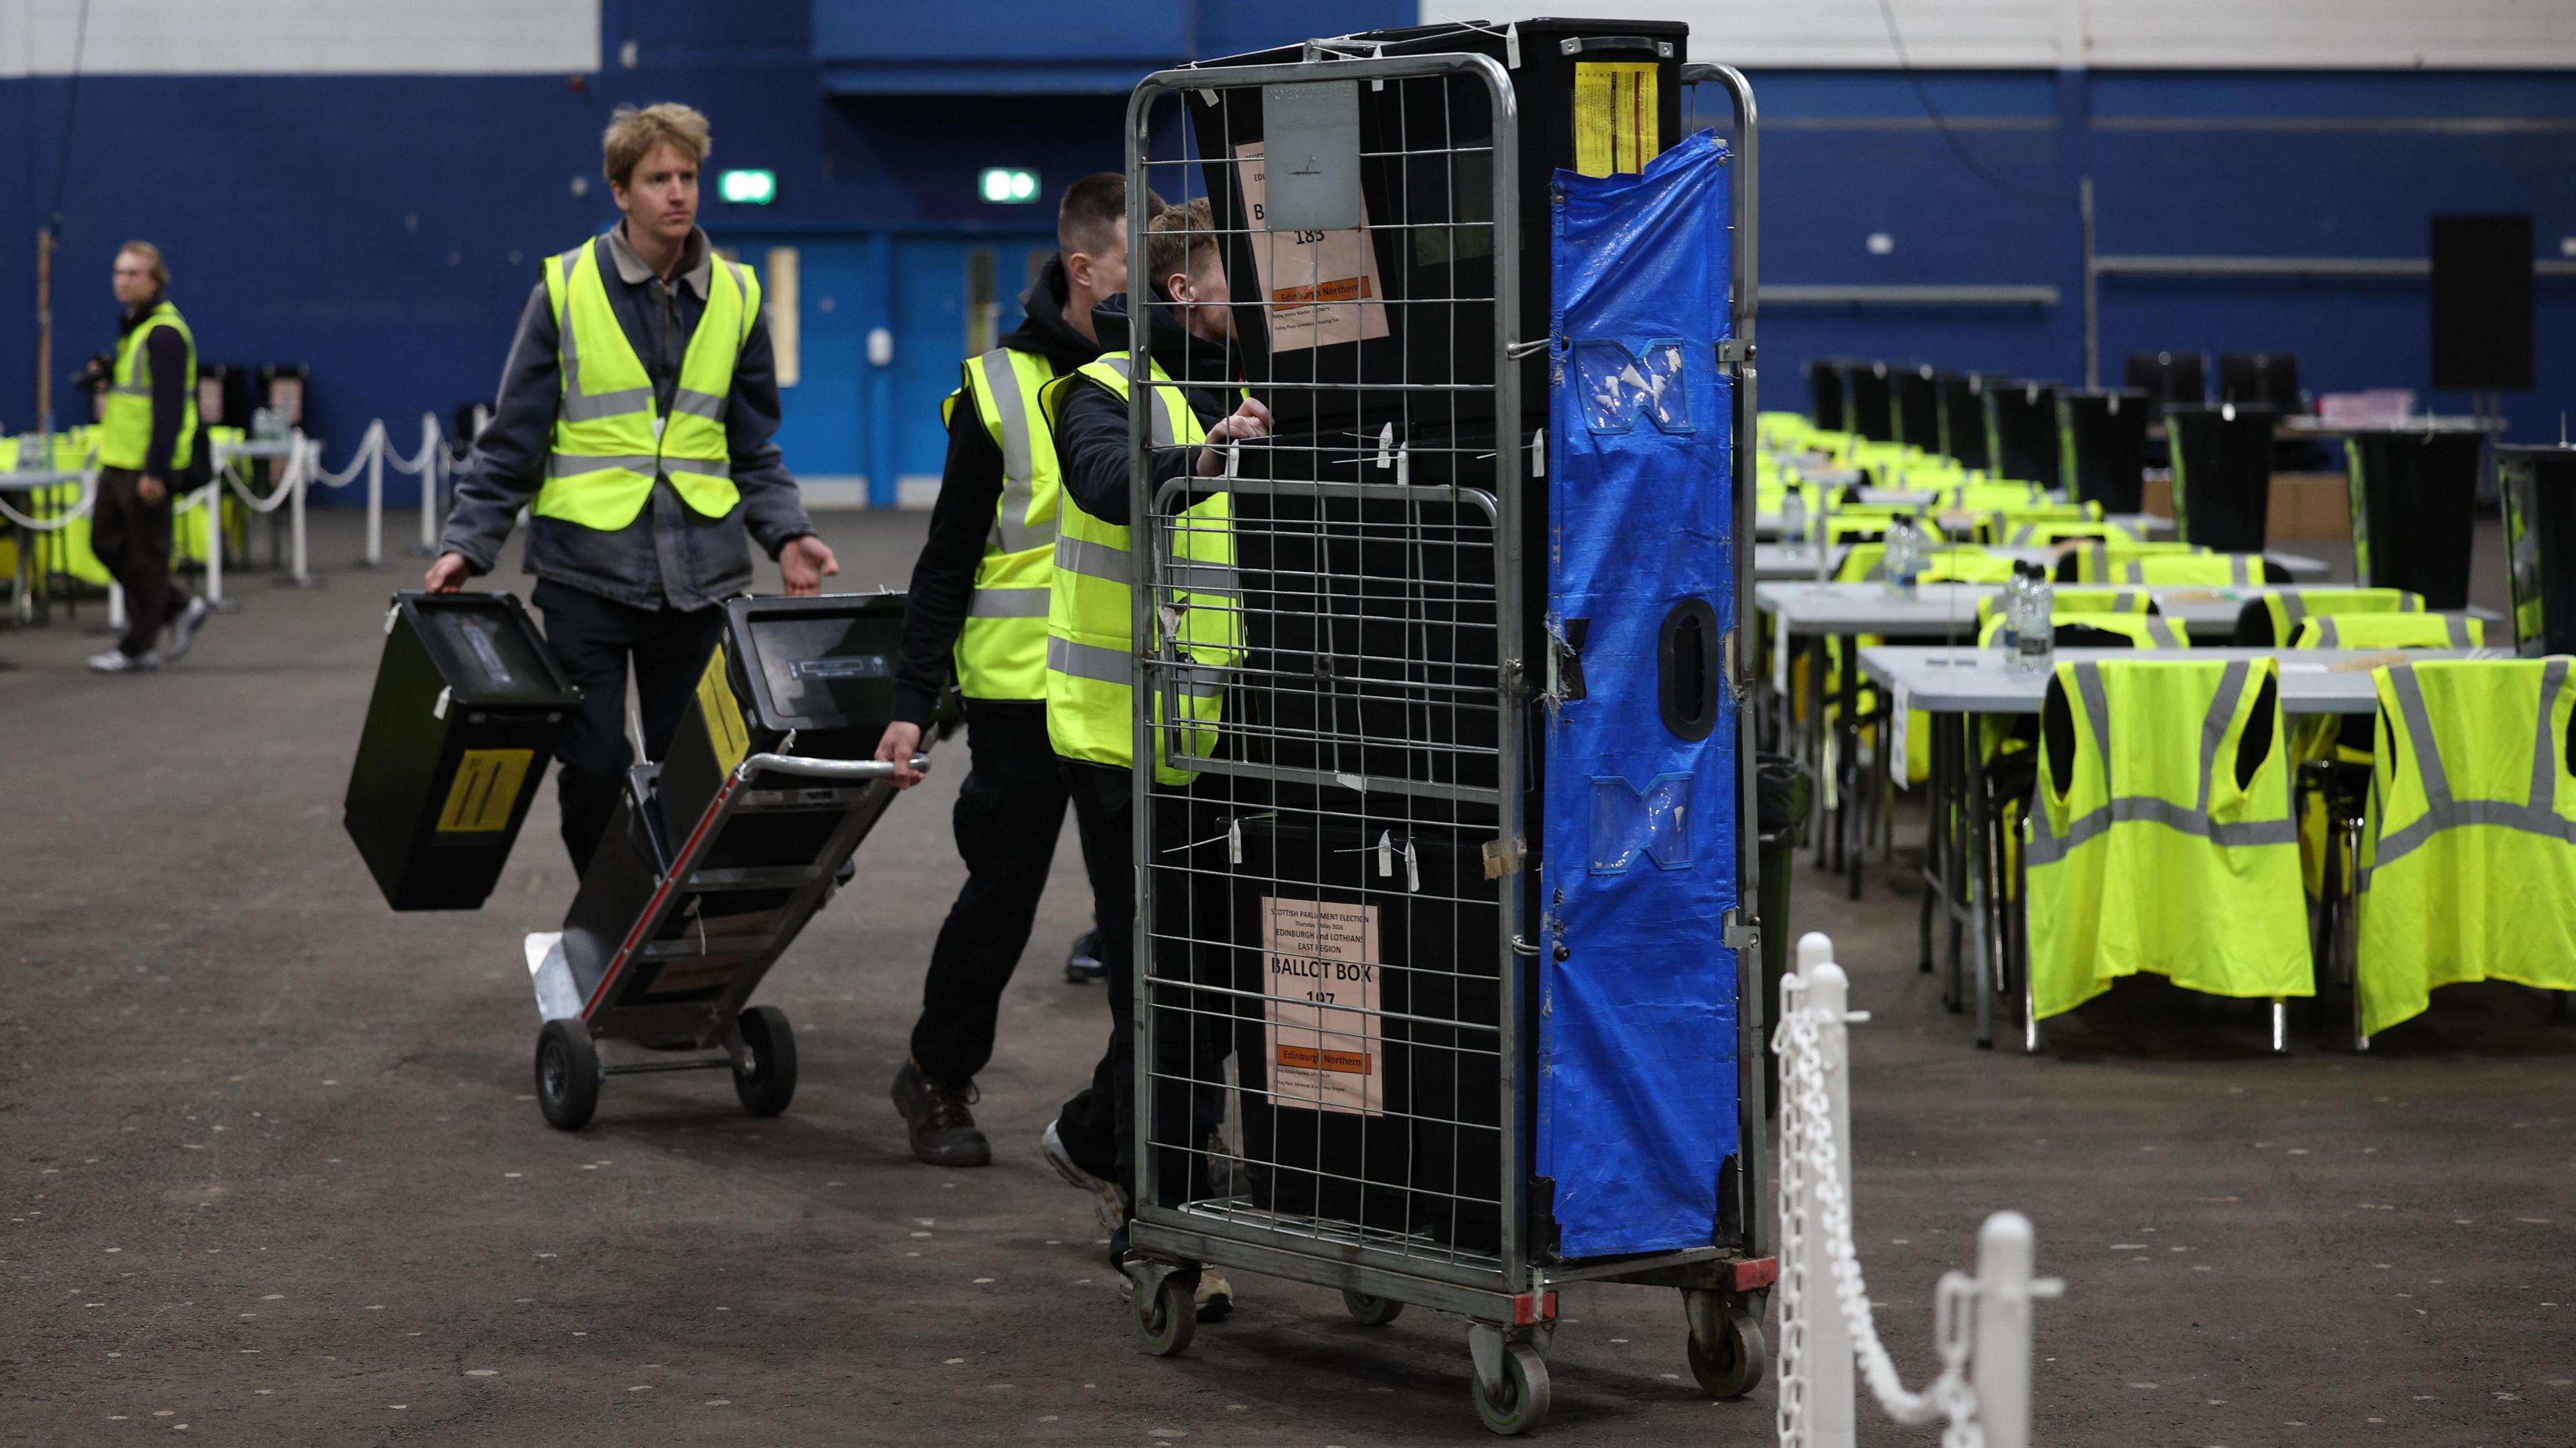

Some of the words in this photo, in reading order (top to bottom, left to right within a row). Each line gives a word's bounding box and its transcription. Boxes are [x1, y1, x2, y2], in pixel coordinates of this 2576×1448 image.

[1276, 928, 1315, 939] EDINBURGH
[1298, 942, 1313, 951] EAST
[1271, 957, 1332, 979] BALLOT
[1336, 963, 1373, 983] BOX
[1324, 1054, 1361, 1066] Northern
